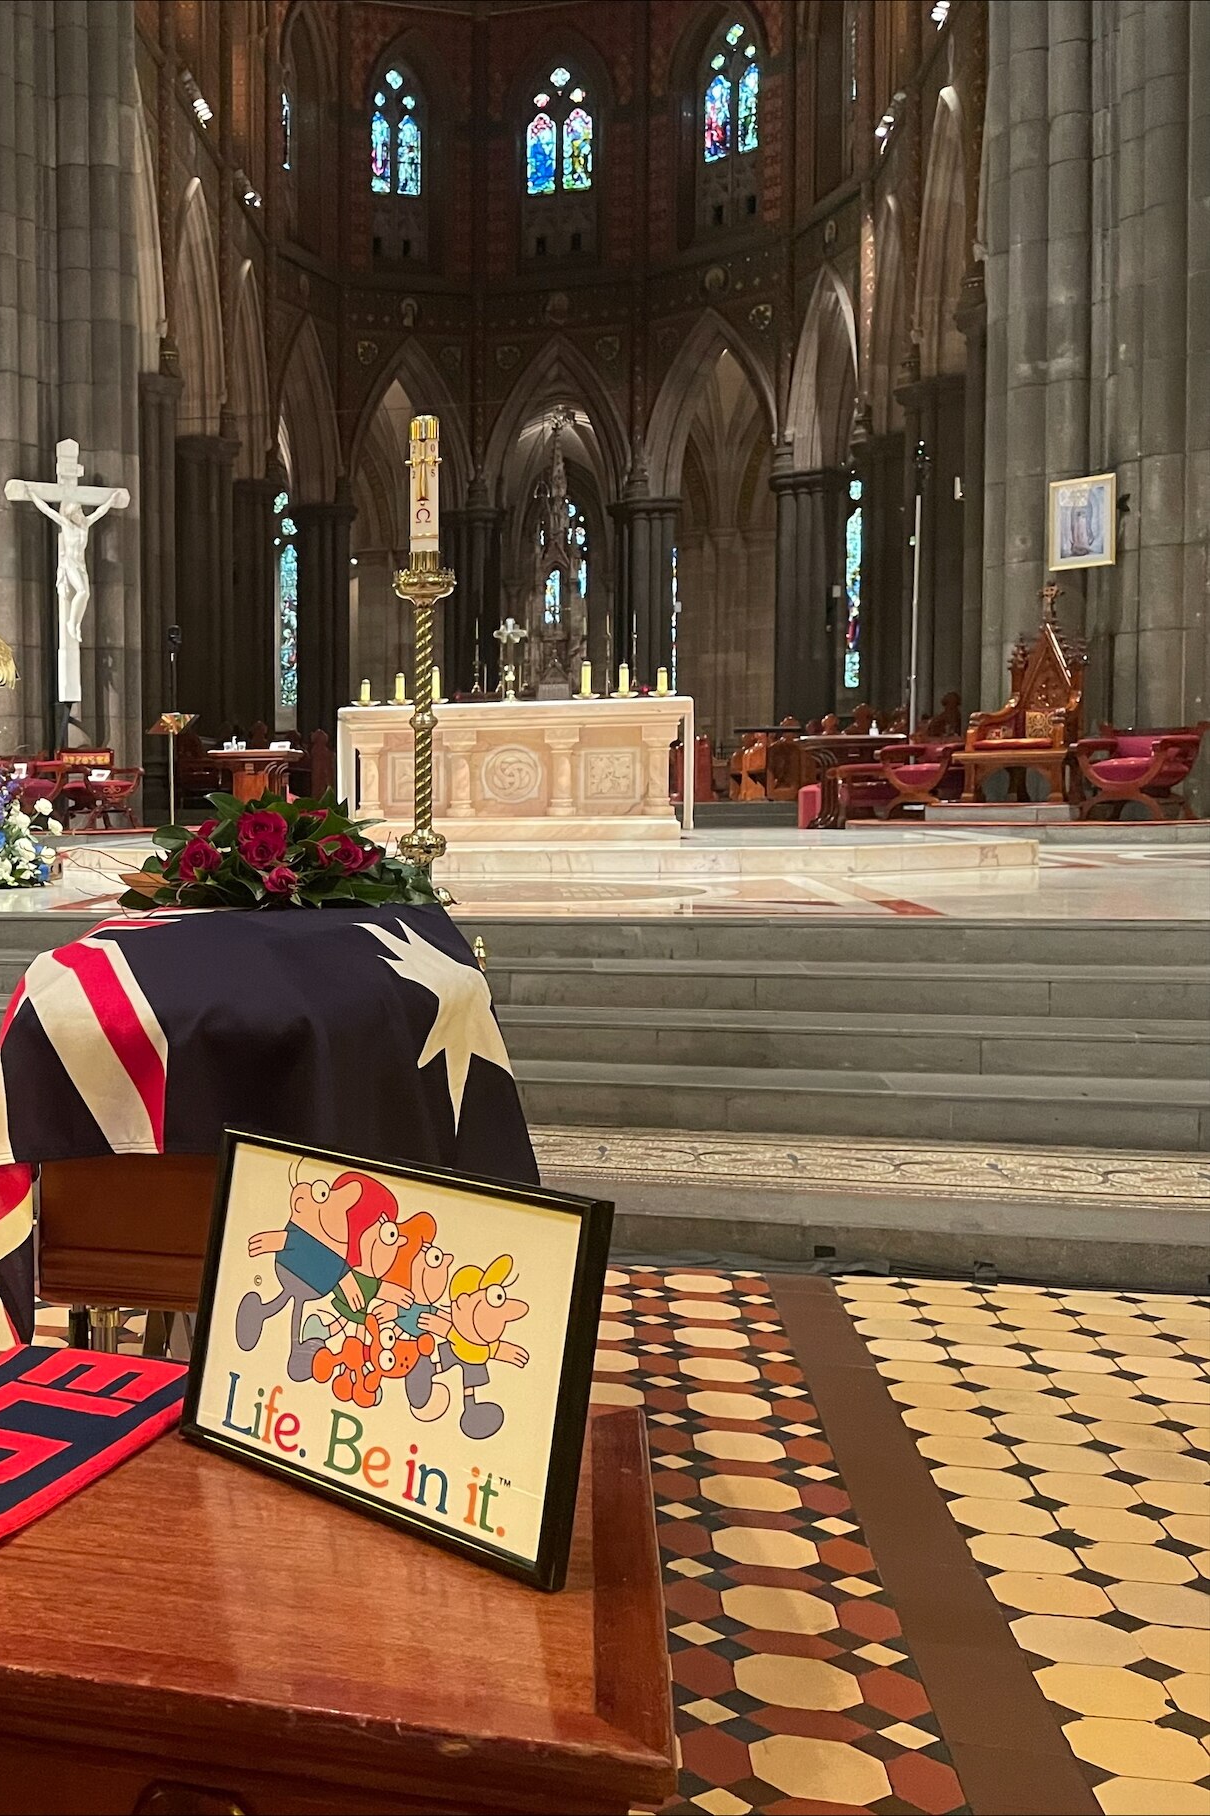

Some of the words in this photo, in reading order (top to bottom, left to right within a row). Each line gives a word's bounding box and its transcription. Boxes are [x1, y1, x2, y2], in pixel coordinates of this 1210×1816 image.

[415, 508, 431, 524] Ω
[222, 1371, 306, 1458] Life.
[323, 1409, 391, 1488] Be
[402, 1443, 448, 1515] in
